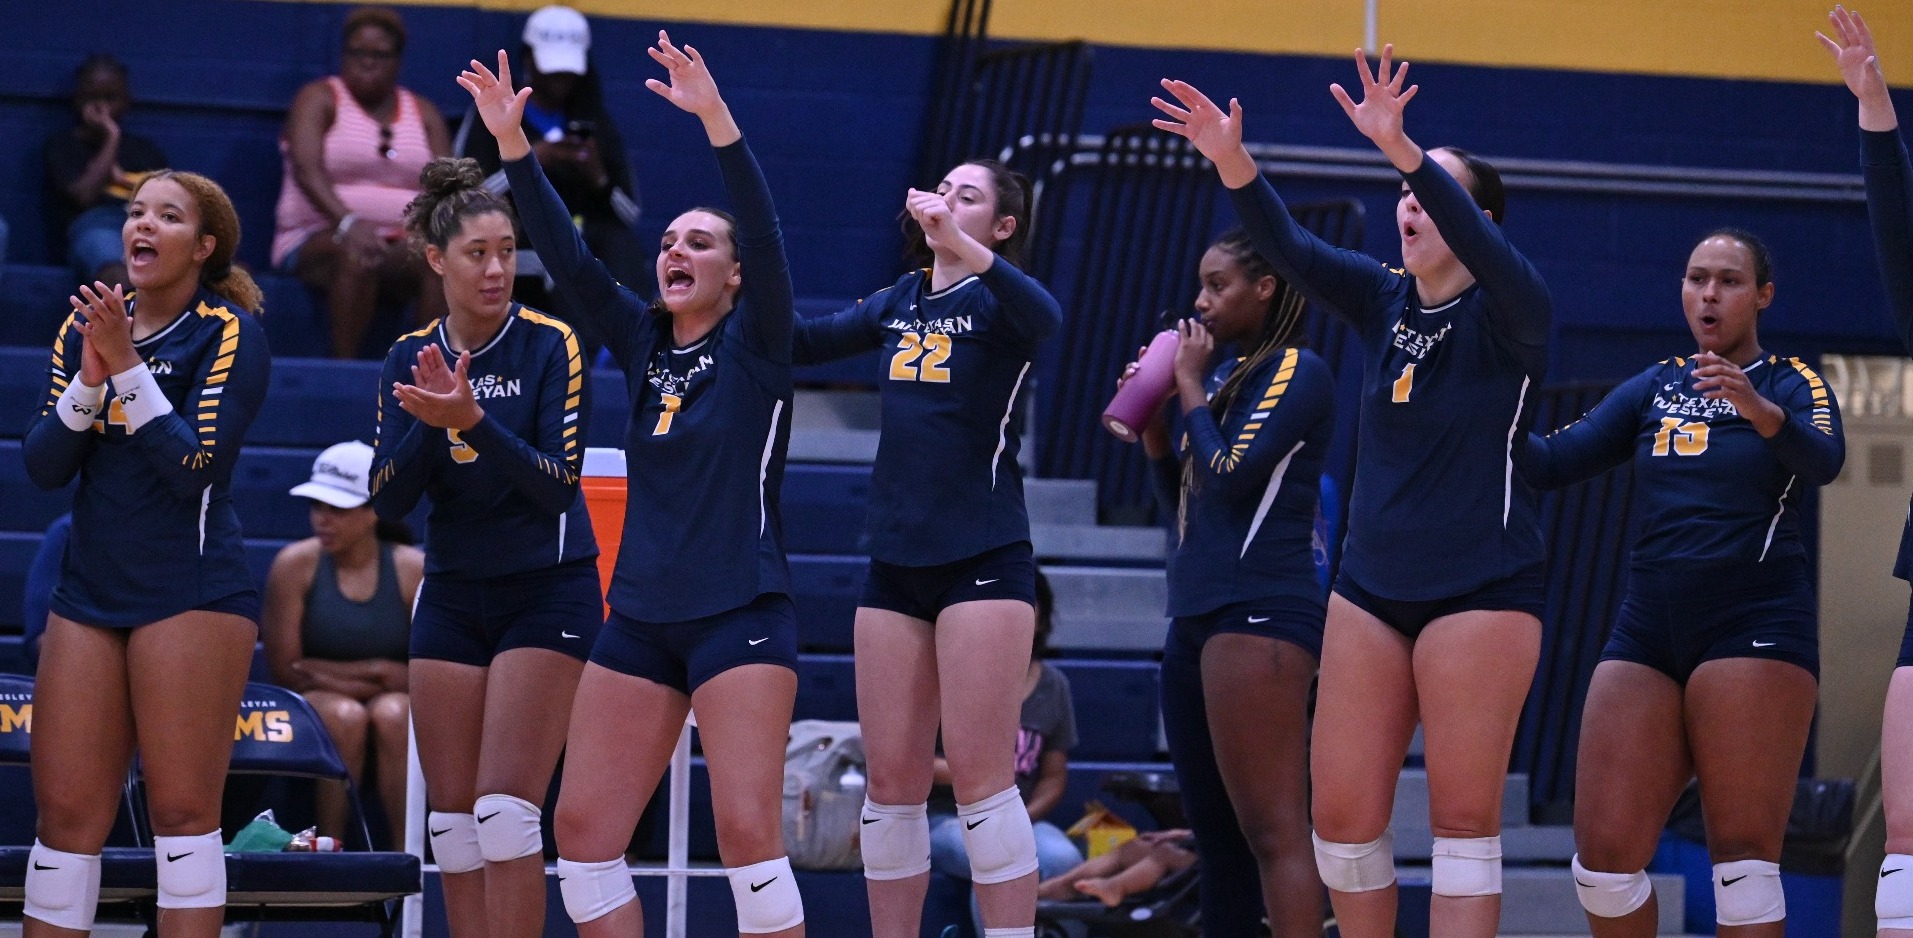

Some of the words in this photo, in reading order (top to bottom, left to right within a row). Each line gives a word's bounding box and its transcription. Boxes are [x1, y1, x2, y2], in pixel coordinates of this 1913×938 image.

[889, 331, 952, 383] 22
[468, 374, 496, 390] XAS
[473, 378, 521, 400] EYAN
[240, 700, 277, 708] LEYAN
[234, 710, 294, 743] MS
